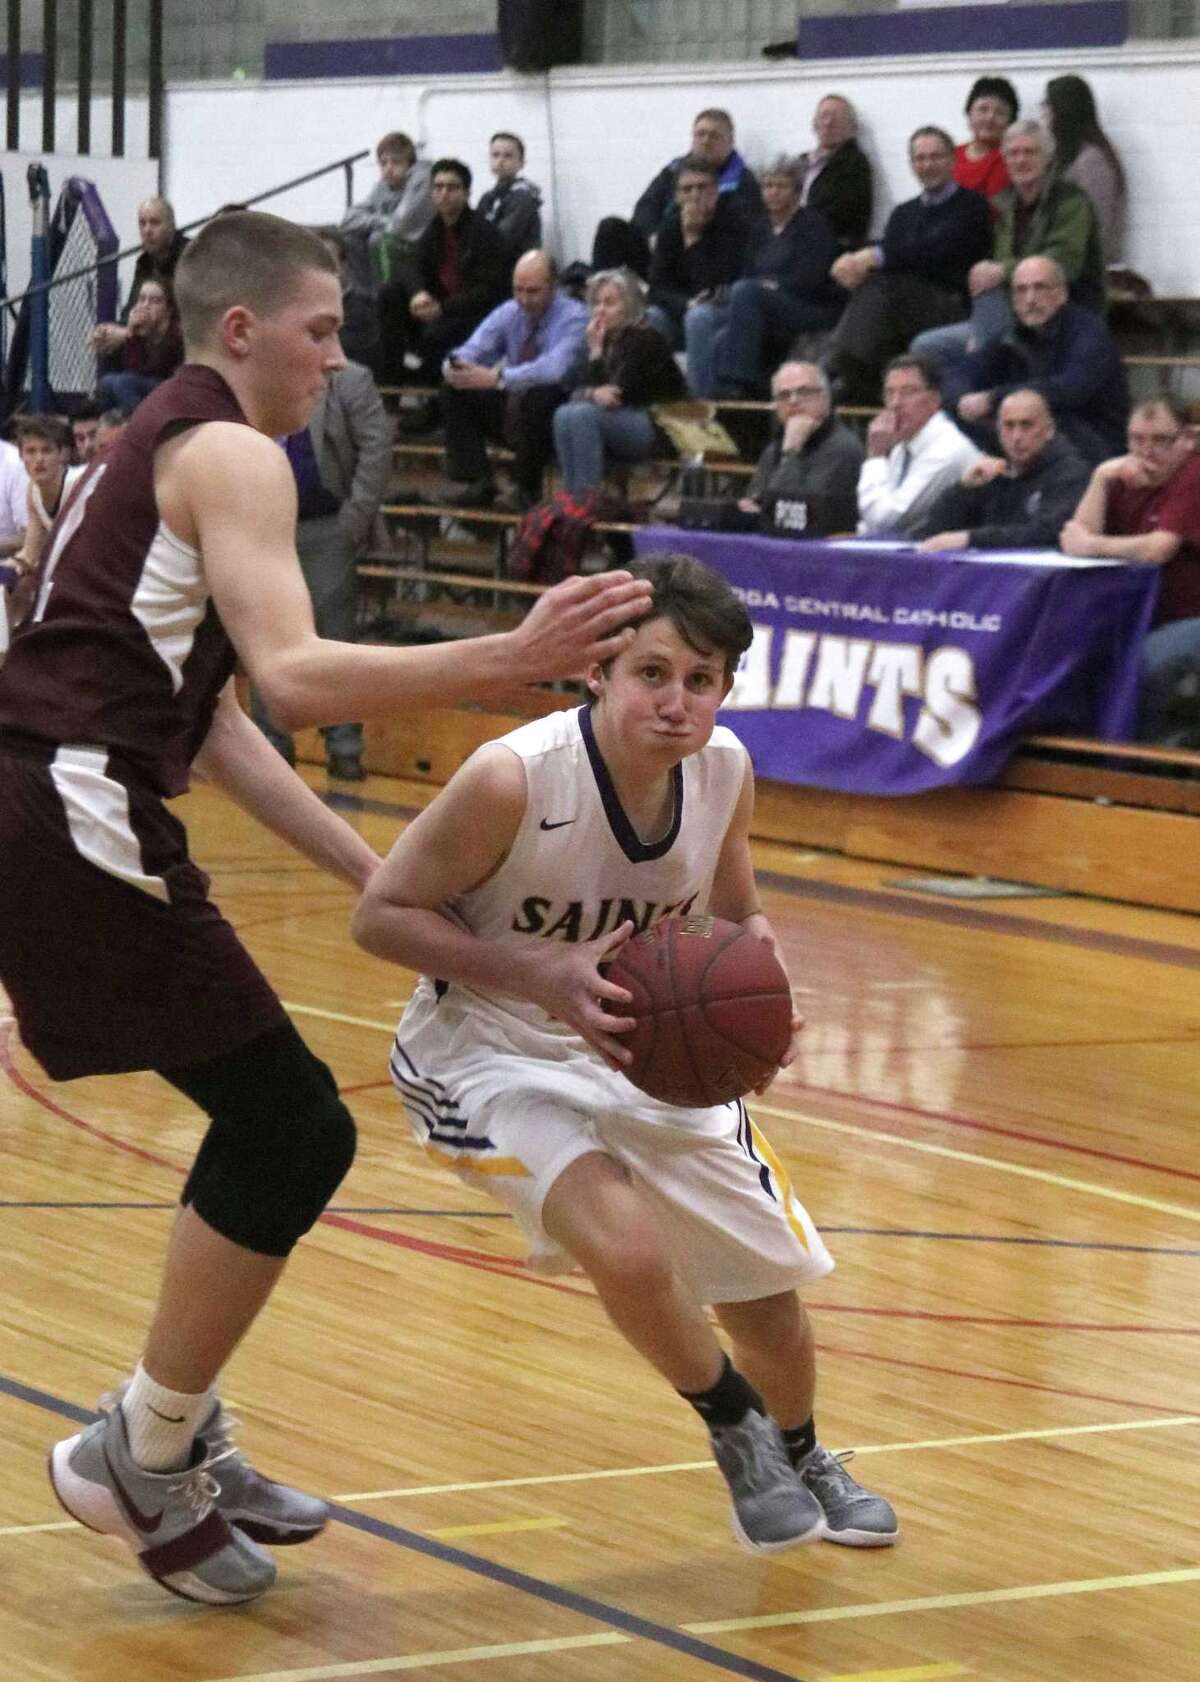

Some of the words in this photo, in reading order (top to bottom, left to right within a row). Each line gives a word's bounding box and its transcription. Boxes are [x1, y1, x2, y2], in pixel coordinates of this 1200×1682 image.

[784, 595, 890, 624] CENTRAL
[893, 606, 1002, 632] CATHOLIC
[718, 623, 982, 768] AINTS
[511, 890, 699, 943] SAIN
